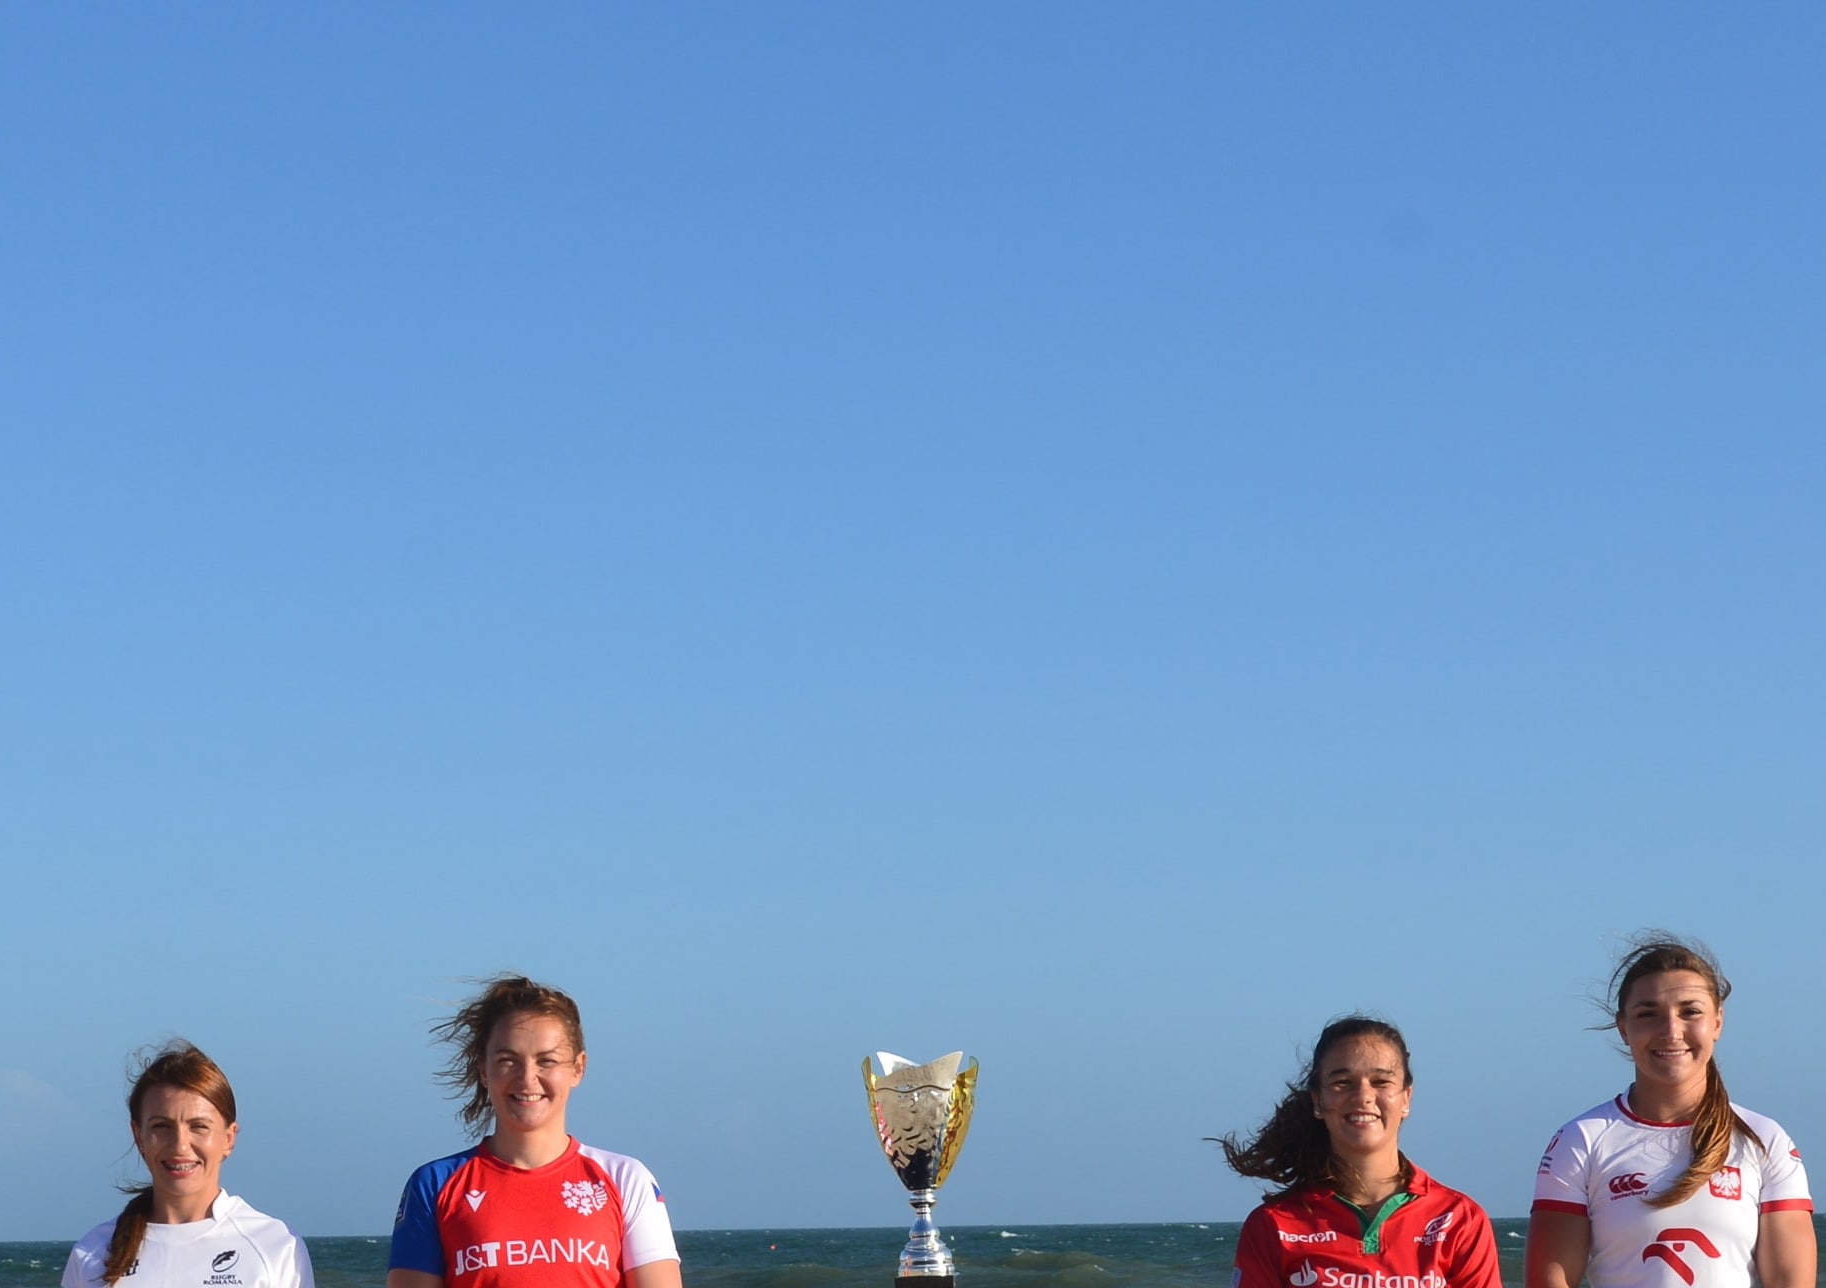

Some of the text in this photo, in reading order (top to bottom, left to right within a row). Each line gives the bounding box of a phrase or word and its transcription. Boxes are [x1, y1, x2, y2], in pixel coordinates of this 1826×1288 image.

[1277, 1230, 1337, 1243] macron
[455, 1238, 610, 1277] J&T BANKA
